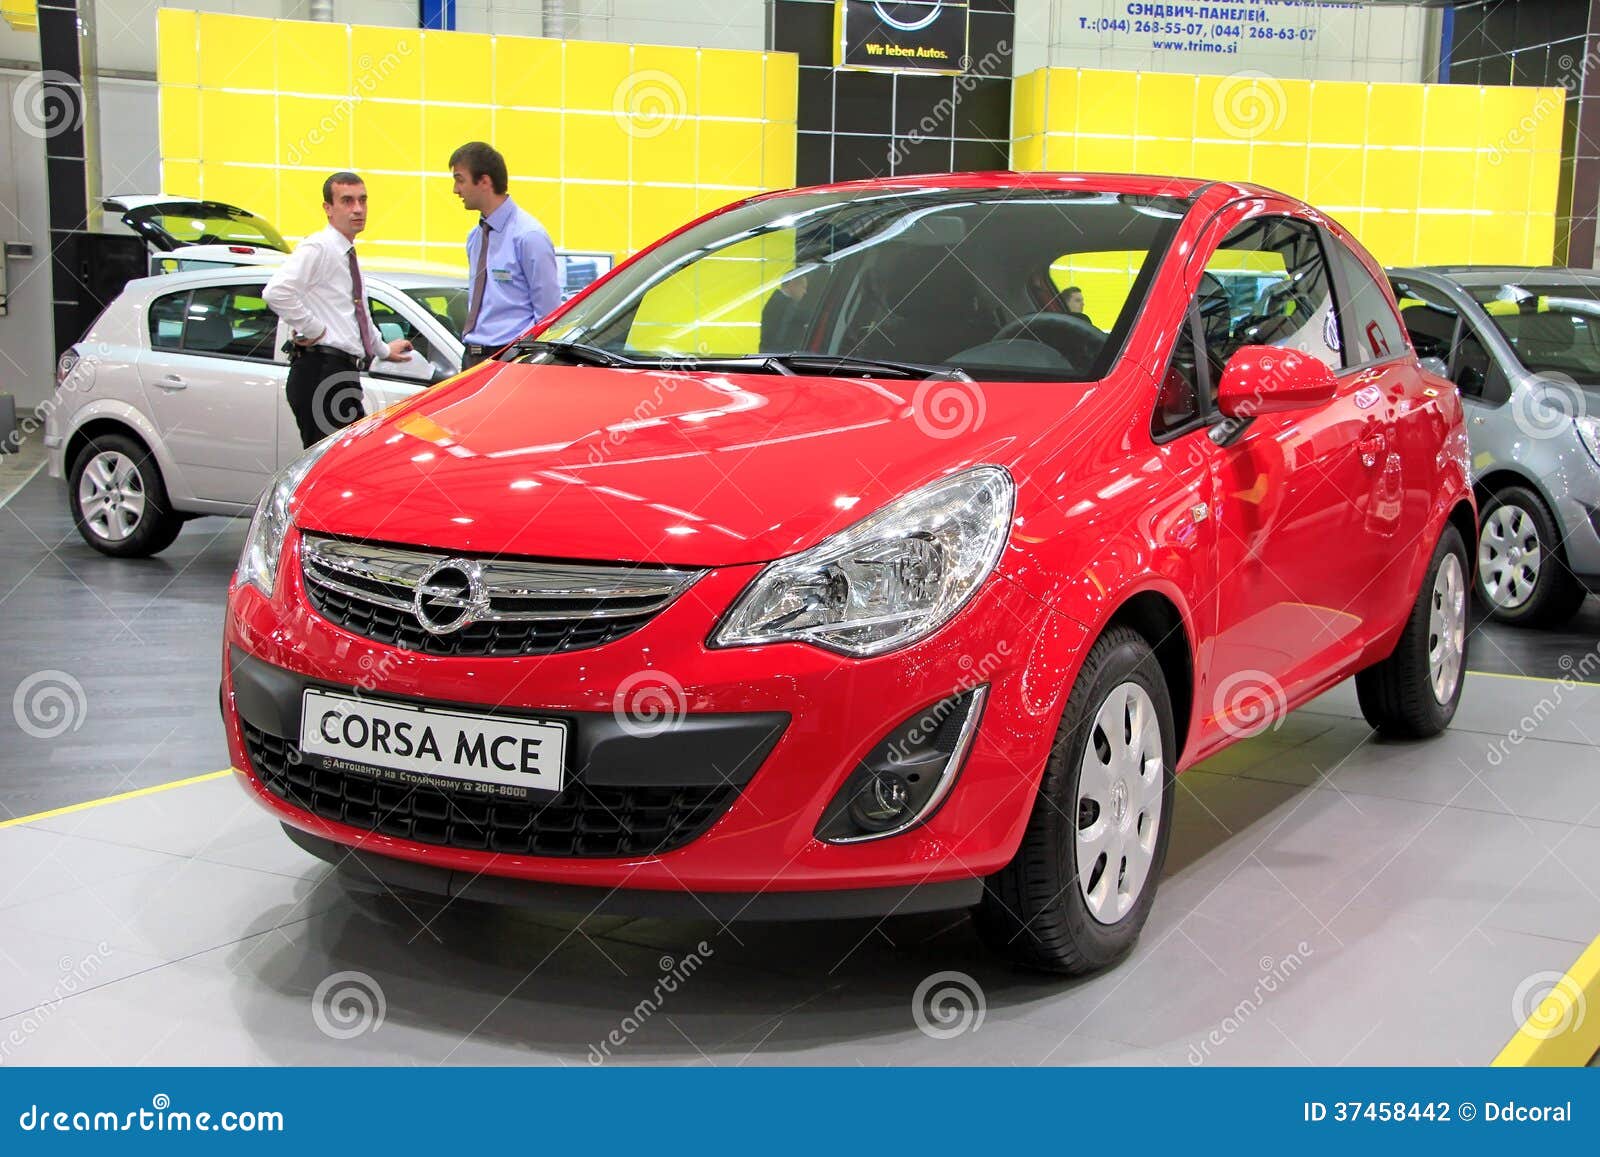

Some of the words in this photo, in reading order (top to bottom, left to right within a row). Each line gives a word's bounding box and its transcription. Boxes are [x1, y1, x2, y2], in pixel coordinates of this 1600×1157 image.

[1127, 3, 1269, 22] СЭНДВИЧ-ПАНЕЛЕЙ.
[1079, 17, 1130, 34] Т.:(044)
[1135, 20, 1207, 37] 268-55-07,
[1211, 24, 1244, 39] (044)
[1250, 27, 1316, 40] 268-63-07
[866, 43, 884, 55] Wir
[885, 44, 915, 57] leben
[916, 46, 948, 59] Autos.
[1153, 39, 1237, 53] www.trimo.si
[320, 710, 442, 762] CORSA
[453, 731, 543, 775] MCE
[333, 759, 381, 777] Автоцентр
[384, 769, 396, 779] на
[400, 771, 460, 791] Столичному
[475, 783, 527, 797] 206-8000
